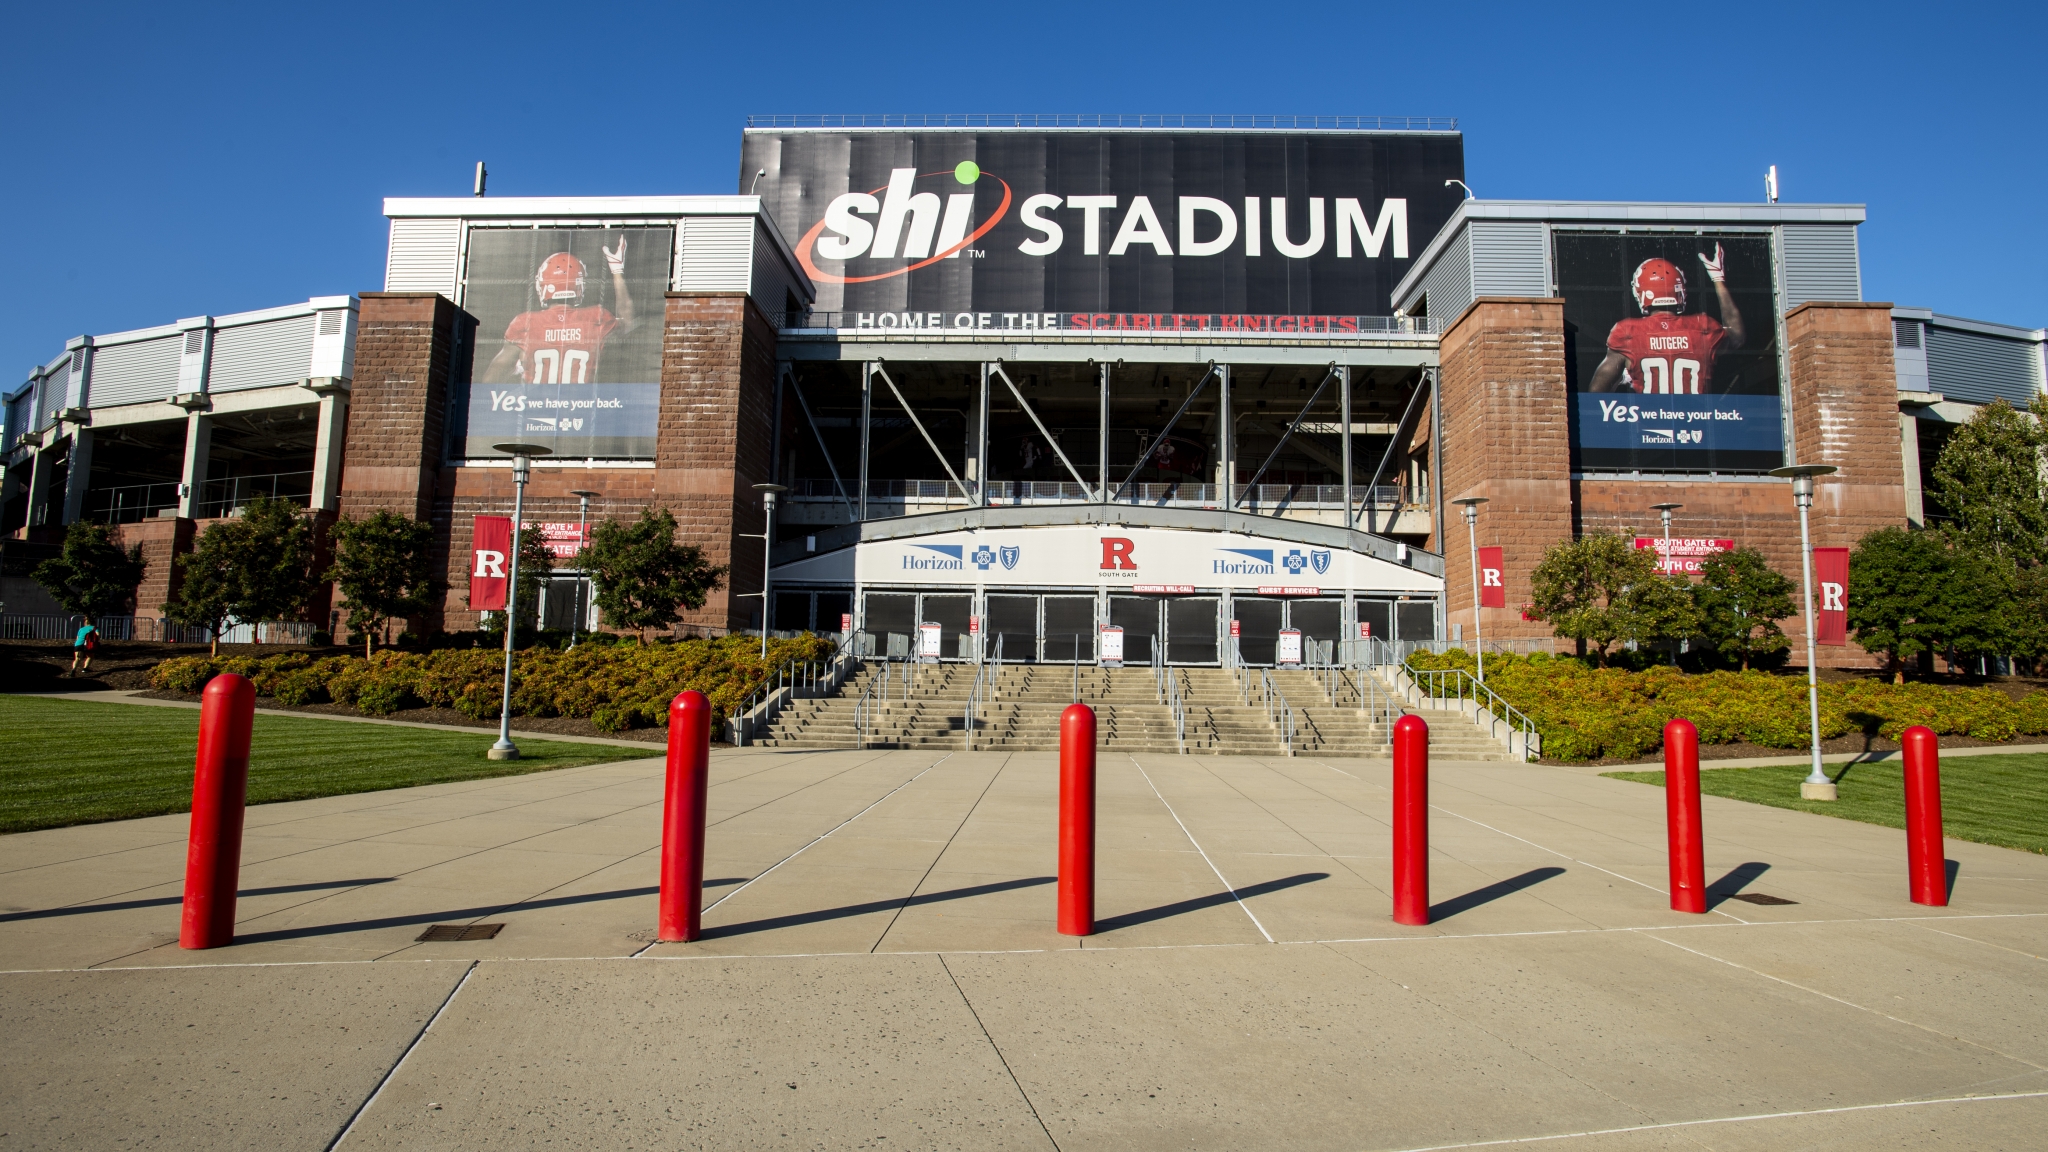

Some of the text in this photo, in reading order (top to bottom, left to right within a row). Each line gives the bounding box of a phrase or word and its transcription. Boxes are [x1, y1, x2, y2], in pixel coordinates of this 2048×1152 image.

[817, 161, 1409, 259] shi STADIUM
[857, 312, 1358, 333] HOME OF THE SCARLET KNIGHTS
[545, 328, 581, 342] RUTGERS
[1649, 336, 1689, 350] RUTGERS
[490, 390, 623, 412] Yes we have your back.
[1599, 400, 1743, 423] Yes we have your back.
[526, 423, 556, 432] Horizon
[1641, 434, 1674, 444] Horizon
[1684, 539, 1706, 547] GATE
[902, 555, 963, 570] Horizon
[1100, 537, 1137, 570] R
[473, 550, 506, 578] R
[1213, 560, 1275, 574] Horizon
[1482, 568, 1502, 587] R
[1821, 582, 1844, 611] R
